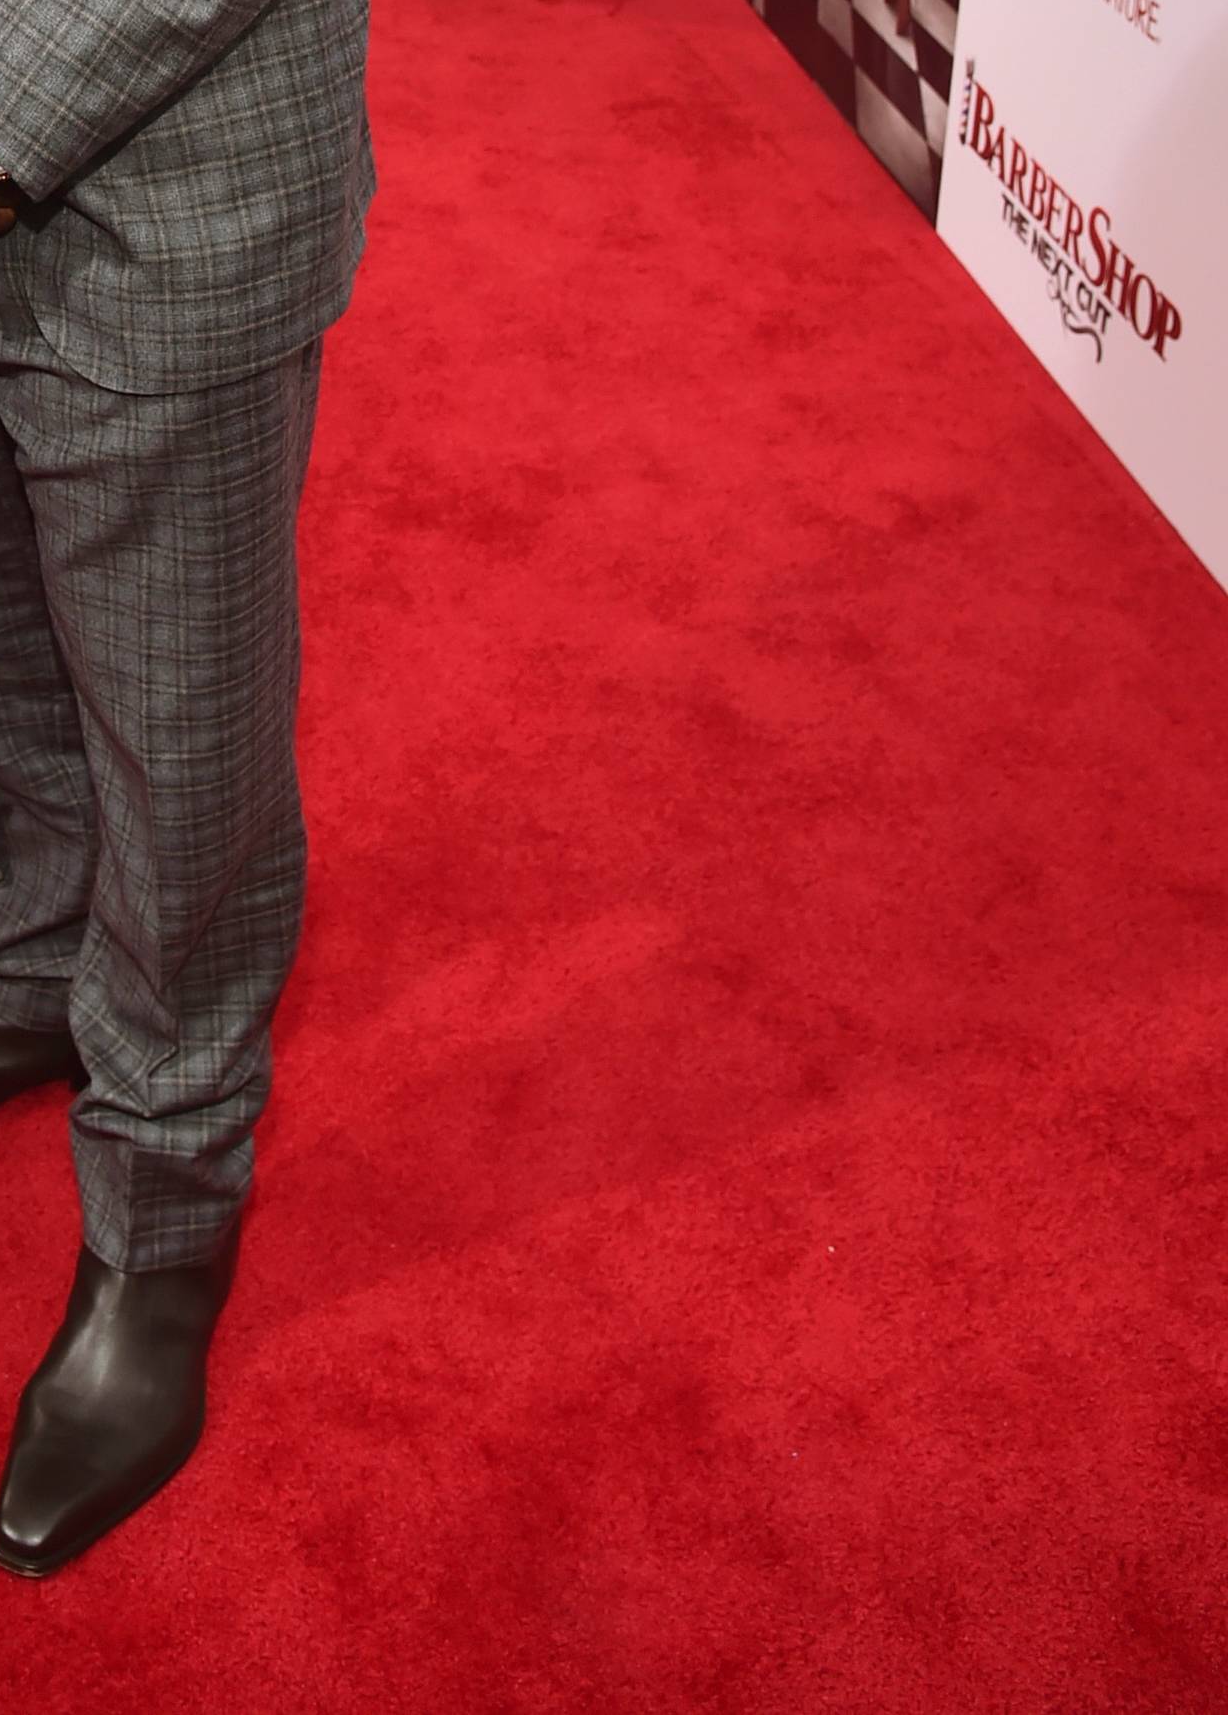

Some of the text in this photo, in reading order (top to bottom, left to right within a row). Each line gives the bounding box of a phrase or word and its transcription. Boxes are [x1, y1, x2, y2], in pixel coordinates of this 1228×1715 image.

[970, 80, 1182, 362] BARBERSHOP
[1001, 193, 1112, 334] THE NEXT CUT
